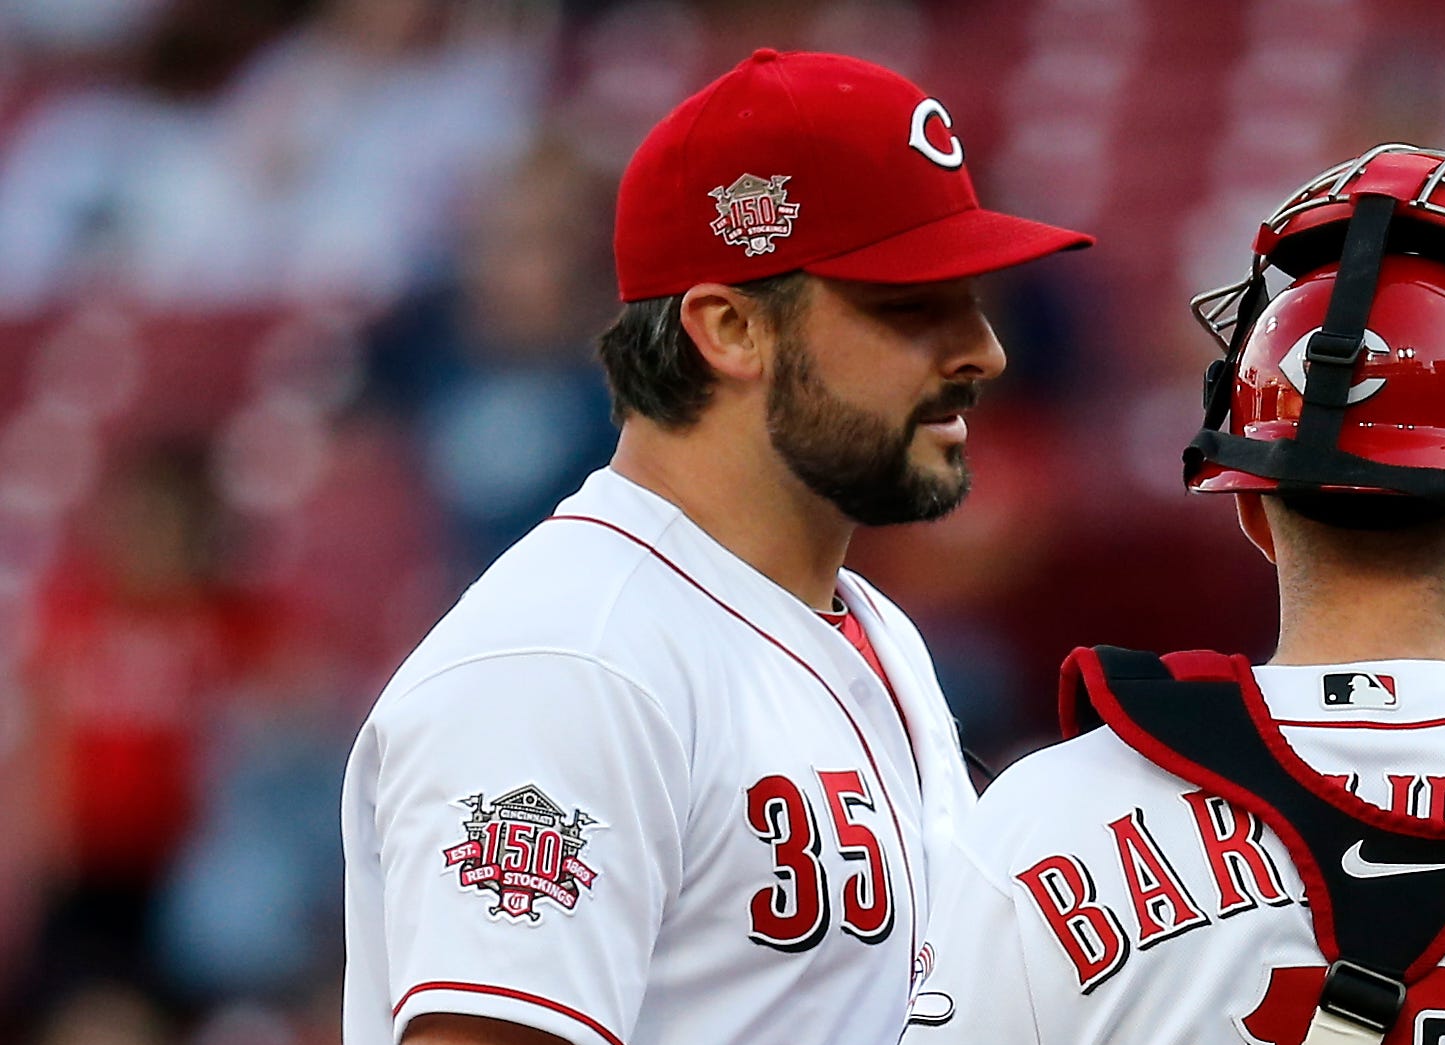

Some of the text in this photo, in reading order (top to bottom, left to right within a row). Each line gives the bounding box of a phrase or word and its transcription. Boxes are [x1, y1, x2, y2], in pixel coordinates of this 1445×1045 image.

[908, 97, 964, 171] C
[729, 195, 776, 229] 150
[450, 844, 476, 860] EST.
[481, 822, 563, 882] 150
[742, 765, 895, 953] 35
[466, 866, 576, 908] RED STOCKINGS
